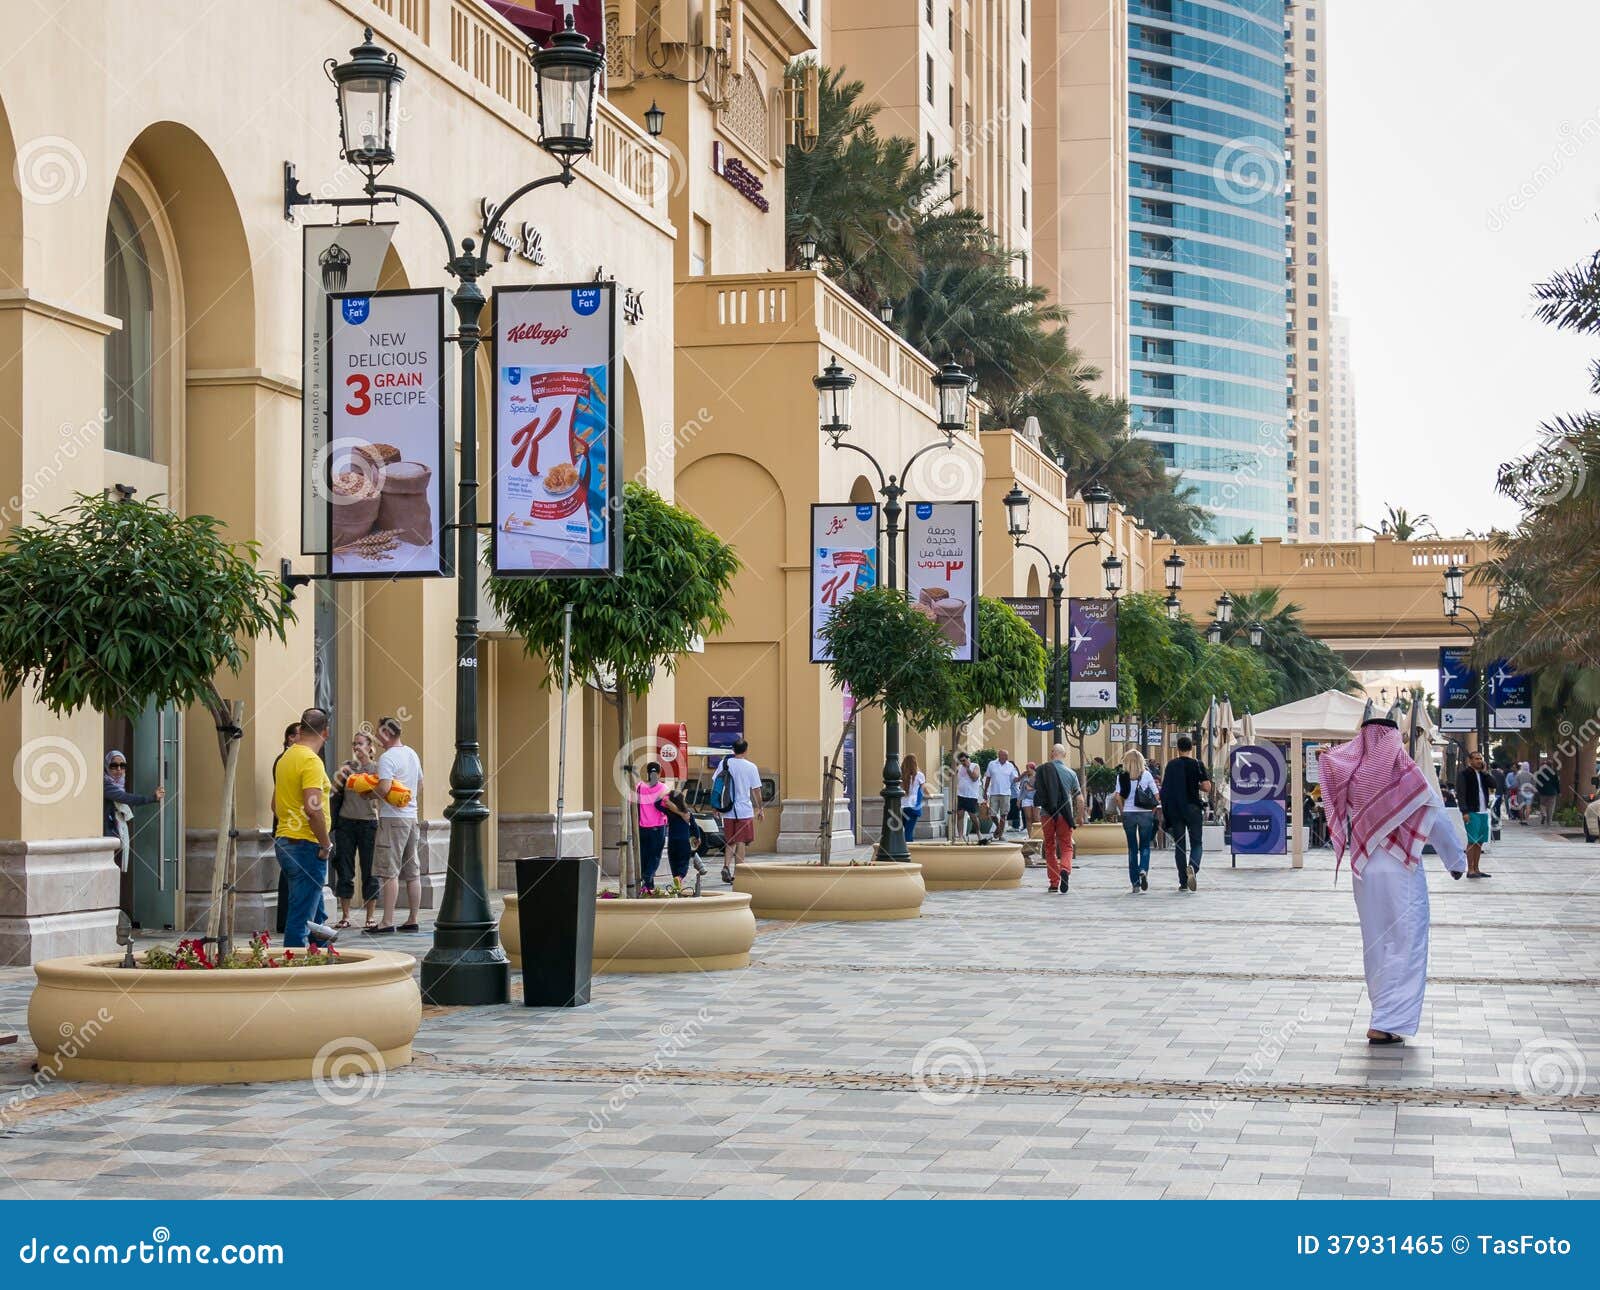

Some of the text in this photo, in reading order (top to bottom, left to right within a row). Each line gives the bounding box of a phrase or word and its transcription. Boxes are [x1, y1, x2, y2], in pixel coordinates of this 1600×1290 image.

[576, 288, 596, 297] Low
[346, 299, 366, 307] Low
[578, 299, 594, 308] Fat
[349, 308, 364, 317] Fat
[369, 332, 407, 347] NEW
[507, 322, 570, 345] Kellogg's
[348, 351, 428, 368] DELICIOUS
[345, 373, 372, 416] 3
[374, 391, 427, 406] RECIPE
[509, 403, 538, 415] Special
[511, 407, 562, 477] K
[945, 560, 964, 582] ٣
